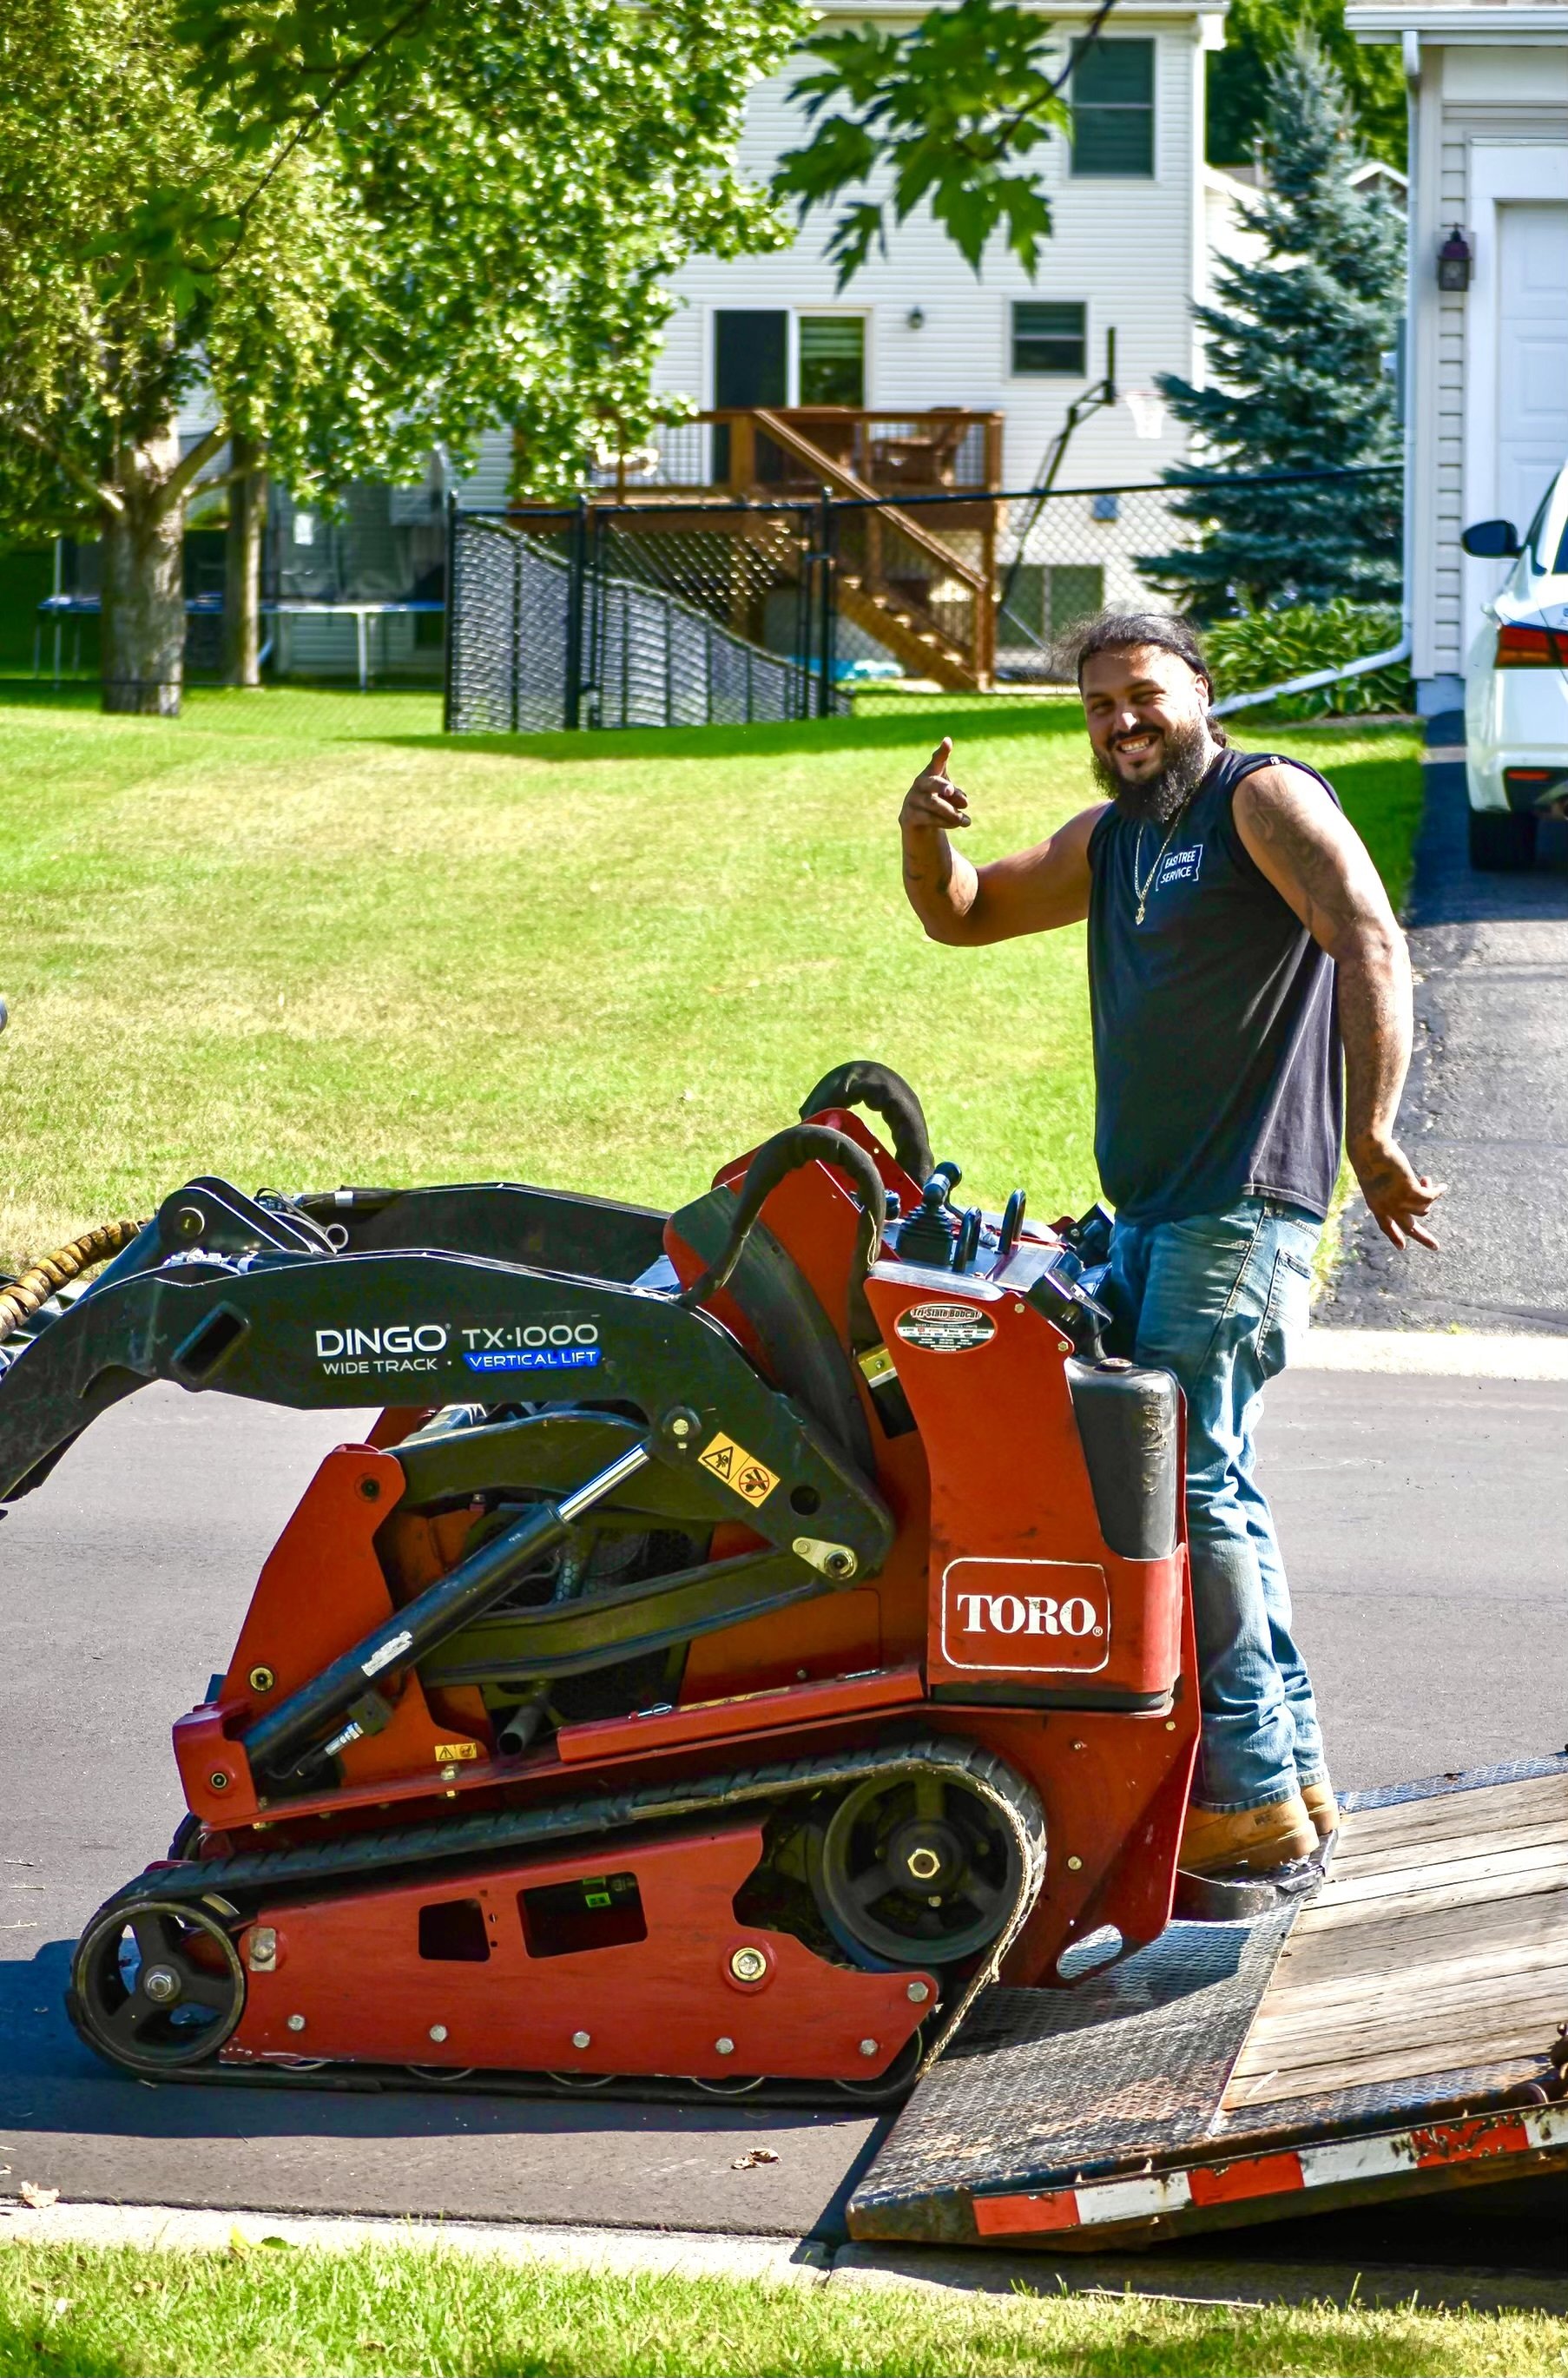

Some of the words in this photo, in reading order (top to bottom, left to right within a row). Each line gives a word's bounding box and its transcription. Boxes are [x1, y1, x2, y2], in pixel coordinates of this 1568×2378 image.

[1178, 850, 1196, 864] TREE
[1160, 866, 1193, 884] SERVICE
[315, 1325, 447, 1357] DINGO
[323, 1361, 370, 1375] WIDE
[372, 1358, 438, 1373] TRACK
[469, 1353, 556, 1368] VERTICAL
[561, 1351, 597, 1365] LIFT
[957, 1594, 1097, 1637] TORO
